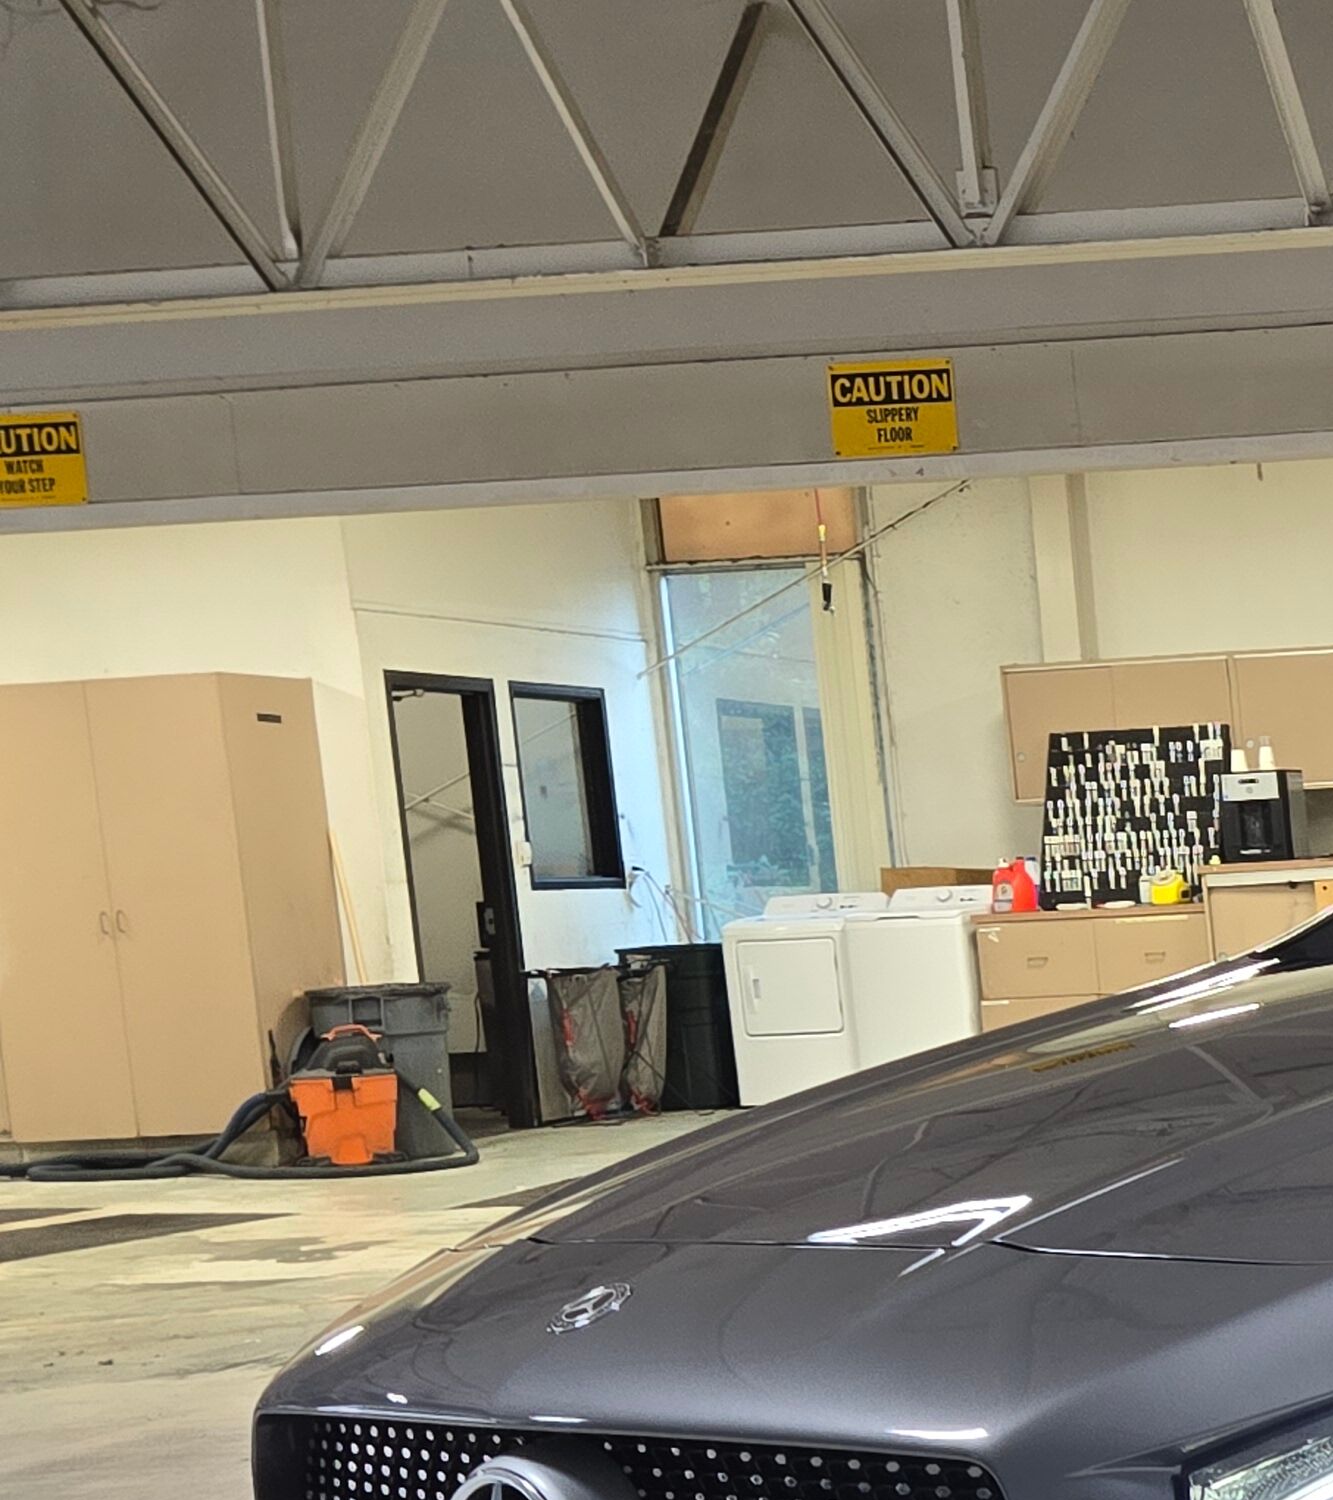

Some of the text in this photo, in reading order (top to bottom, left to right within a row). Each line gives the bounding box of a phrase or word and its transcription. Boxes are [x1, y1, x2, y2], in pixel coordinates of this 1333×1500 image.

[833, 372, 951, 403] CAUTION
[865, 406, 920, 424] SLIPPERY
[0, 425, 78, 454] UTION
[876, 426, 914, 443] FLOOR
[3, 459, 45, 475] WATCH
[27, 477, 56, 493] STEP
